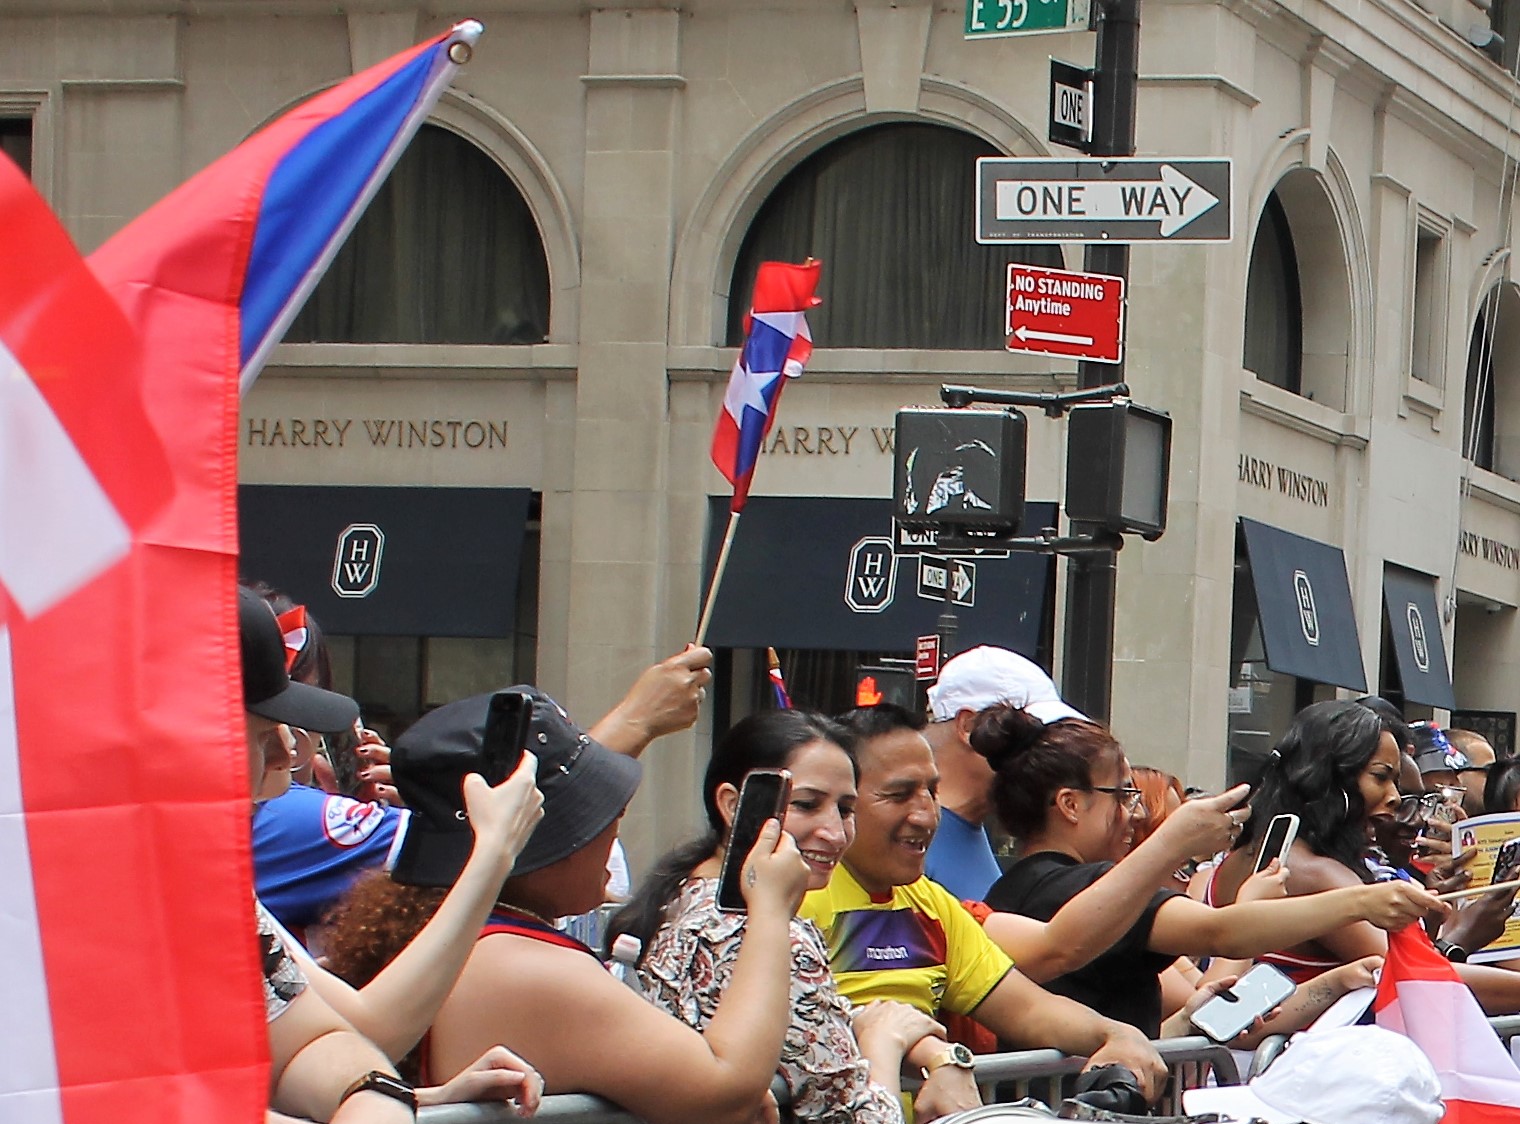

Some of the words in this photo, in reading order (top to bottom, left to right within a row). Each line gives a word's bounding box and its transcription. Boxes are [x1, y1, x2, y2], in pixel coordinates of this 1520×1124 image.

[972, 0, 985, 30] E
[1060, 89, 1084, 124] ONE
[1016, 185, 1087, 216] ONE
[1120, 185, 1193, 217] WAY
[1015, 274, 1035, 292] NO
[1037, 277, 1104, 301] STANDING
[1015, 294, 1071, 316] Anytime
[248, 418, 352, 447] HARRY
[363, 419, 509, 449] WINSTON
[1277, 466, 1329, 508] WINSTON
[1481, 536, 1520, 570] WINSTON
[927, 568, 943, 587] ONE
